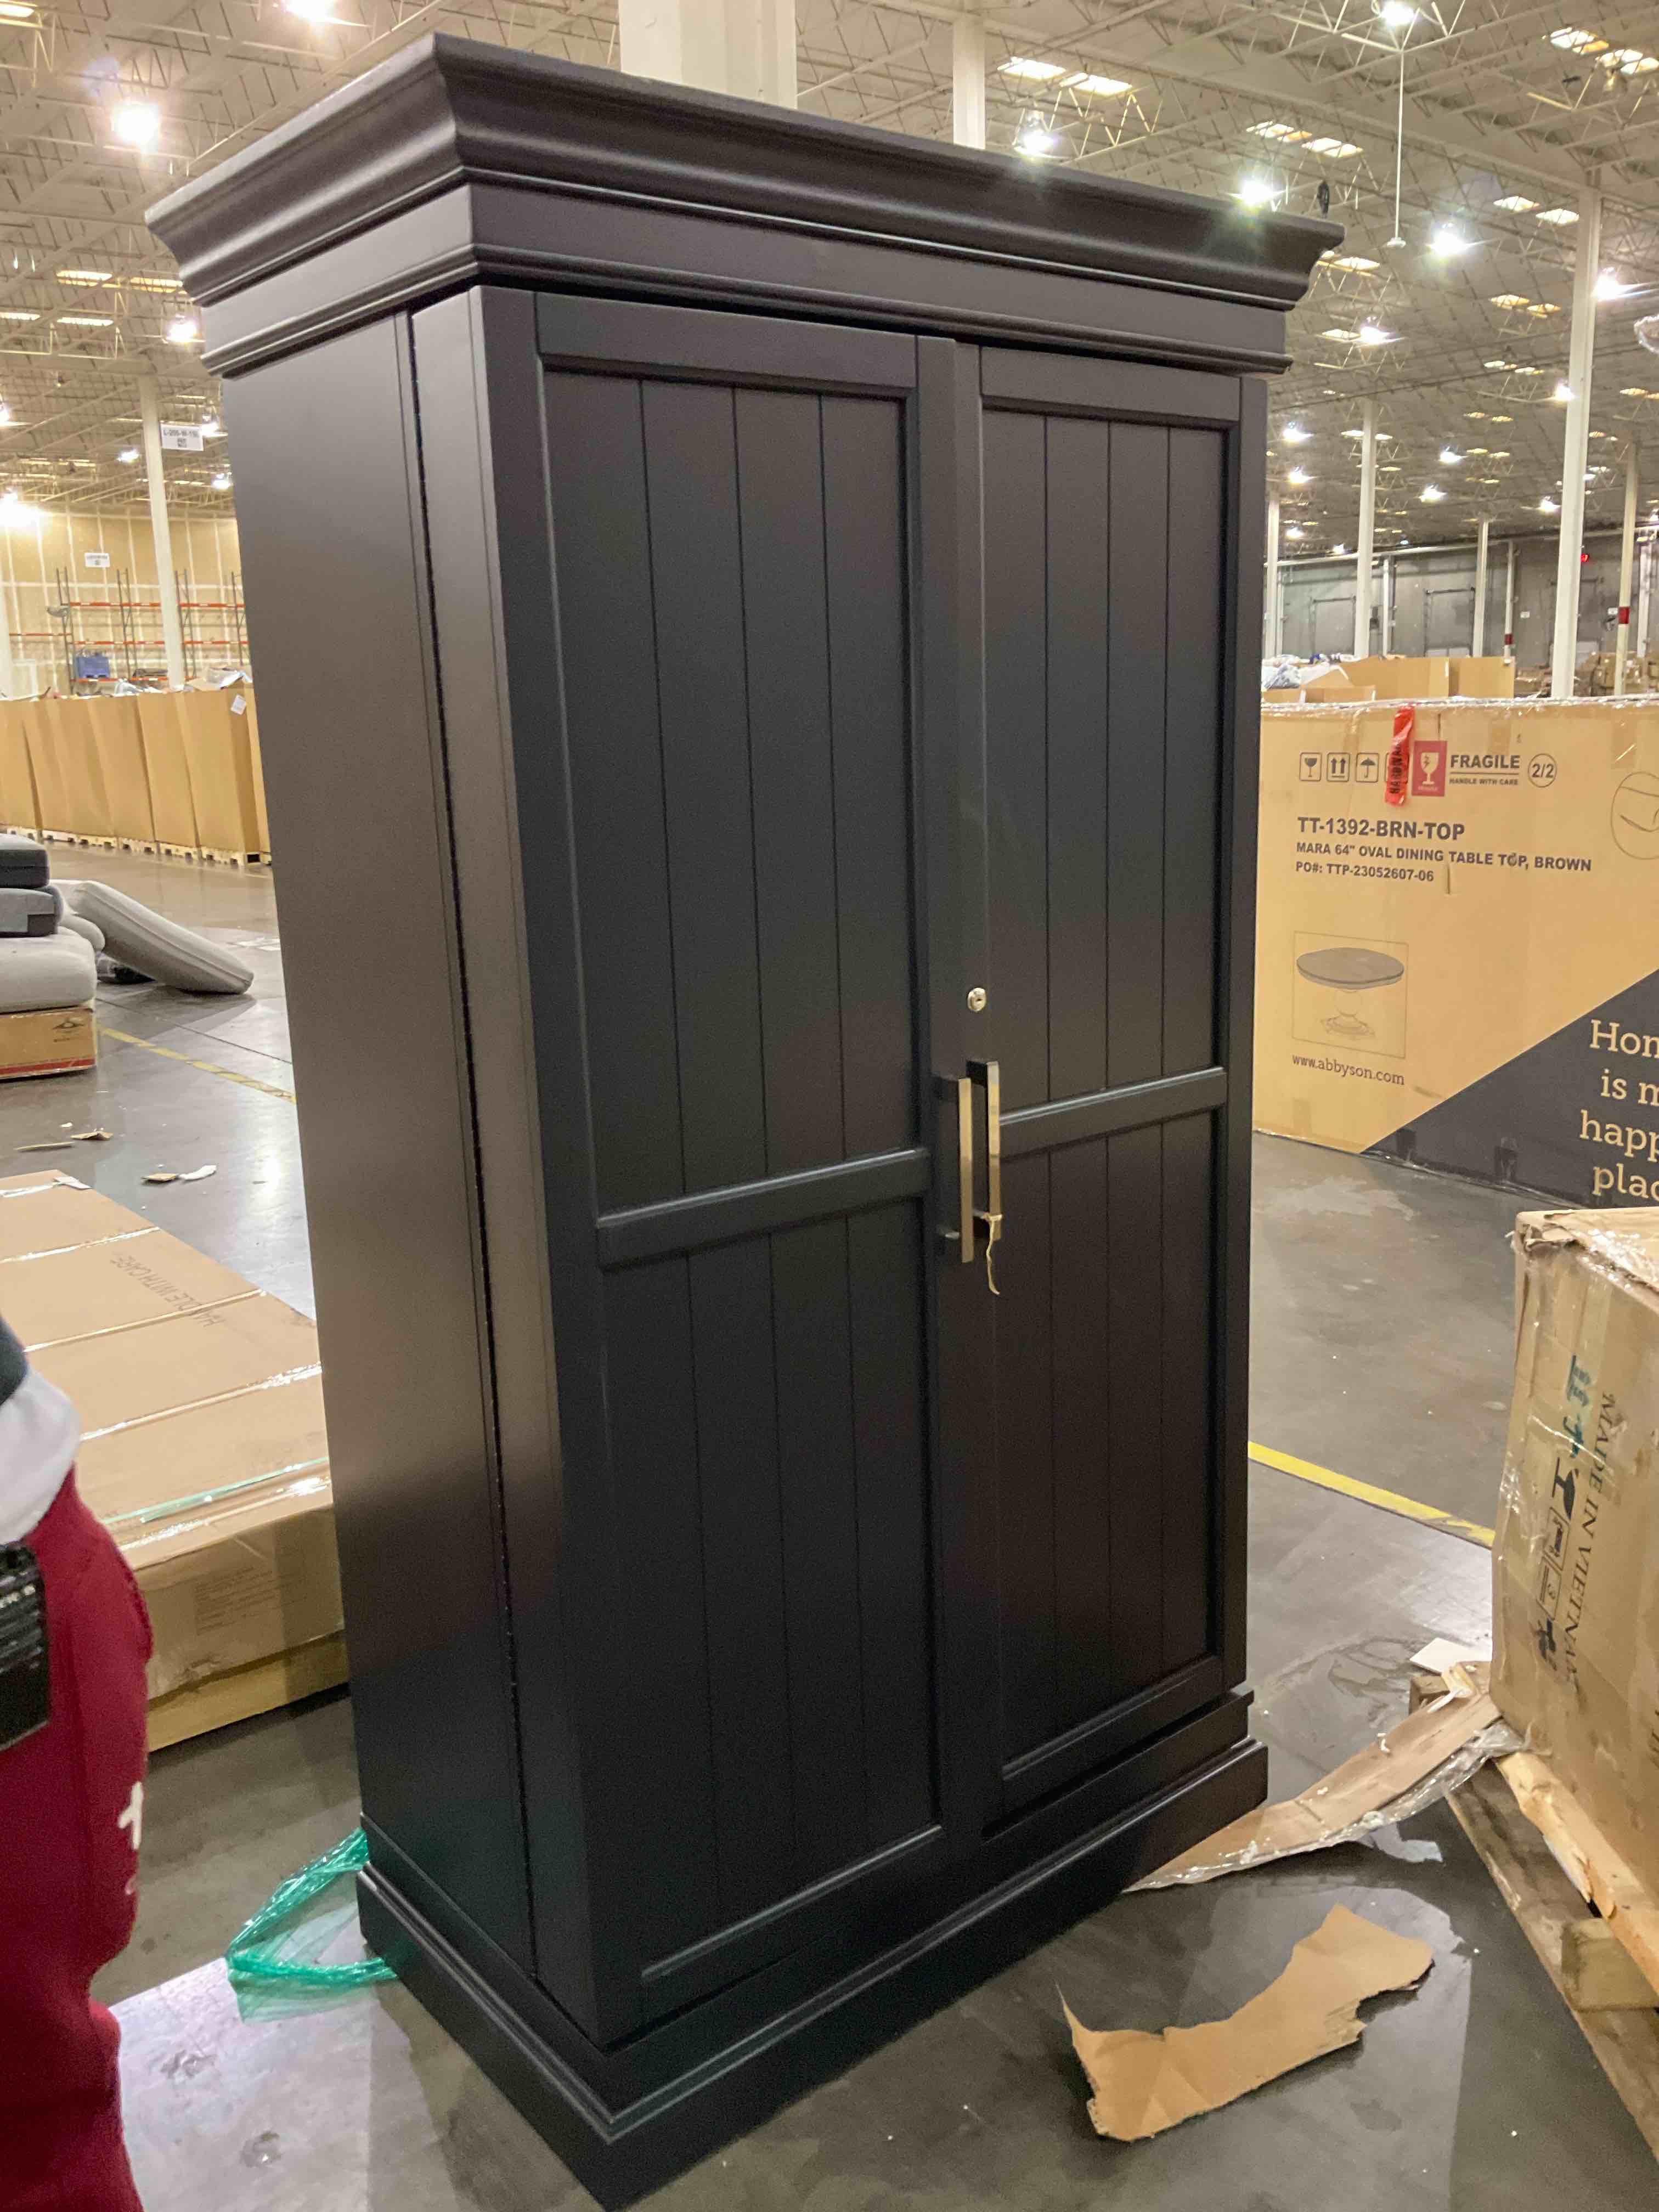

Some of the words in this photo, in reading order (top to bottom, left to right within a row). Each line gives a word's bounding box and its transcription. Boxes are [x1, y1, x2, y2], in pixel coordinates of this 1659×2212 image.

[1450, 754, 1520, 769] FRAGILE
[1531, 763, 1554, 778] 2/2
[1297, 816, 1465, 840] TT-1392-BRN-TOP
[1296, 842, 1331, 854] MARA
[1334, 844, 1355, 855] 64"
[1358, 846, 1392, 858] OVAL
[1396, 848, 1444, 861] DINING
[1448, 851, 1493, 865] TABLE
[1498, 853, 1529, 870] TOP,
[1534, 856, 1592, 871] BROWN
[1296, 861, 1323, 873] PO#:
[1327, 863, 1434, 882] TTP-23052607-06
[1291, 1054, 1405, 1086] www.abbyson.com
[1600, 1068, 1628, 1100] is
[1590, 1392, 1615, 1493] MADE
[1582, 1493, 1599, 1539] IN
